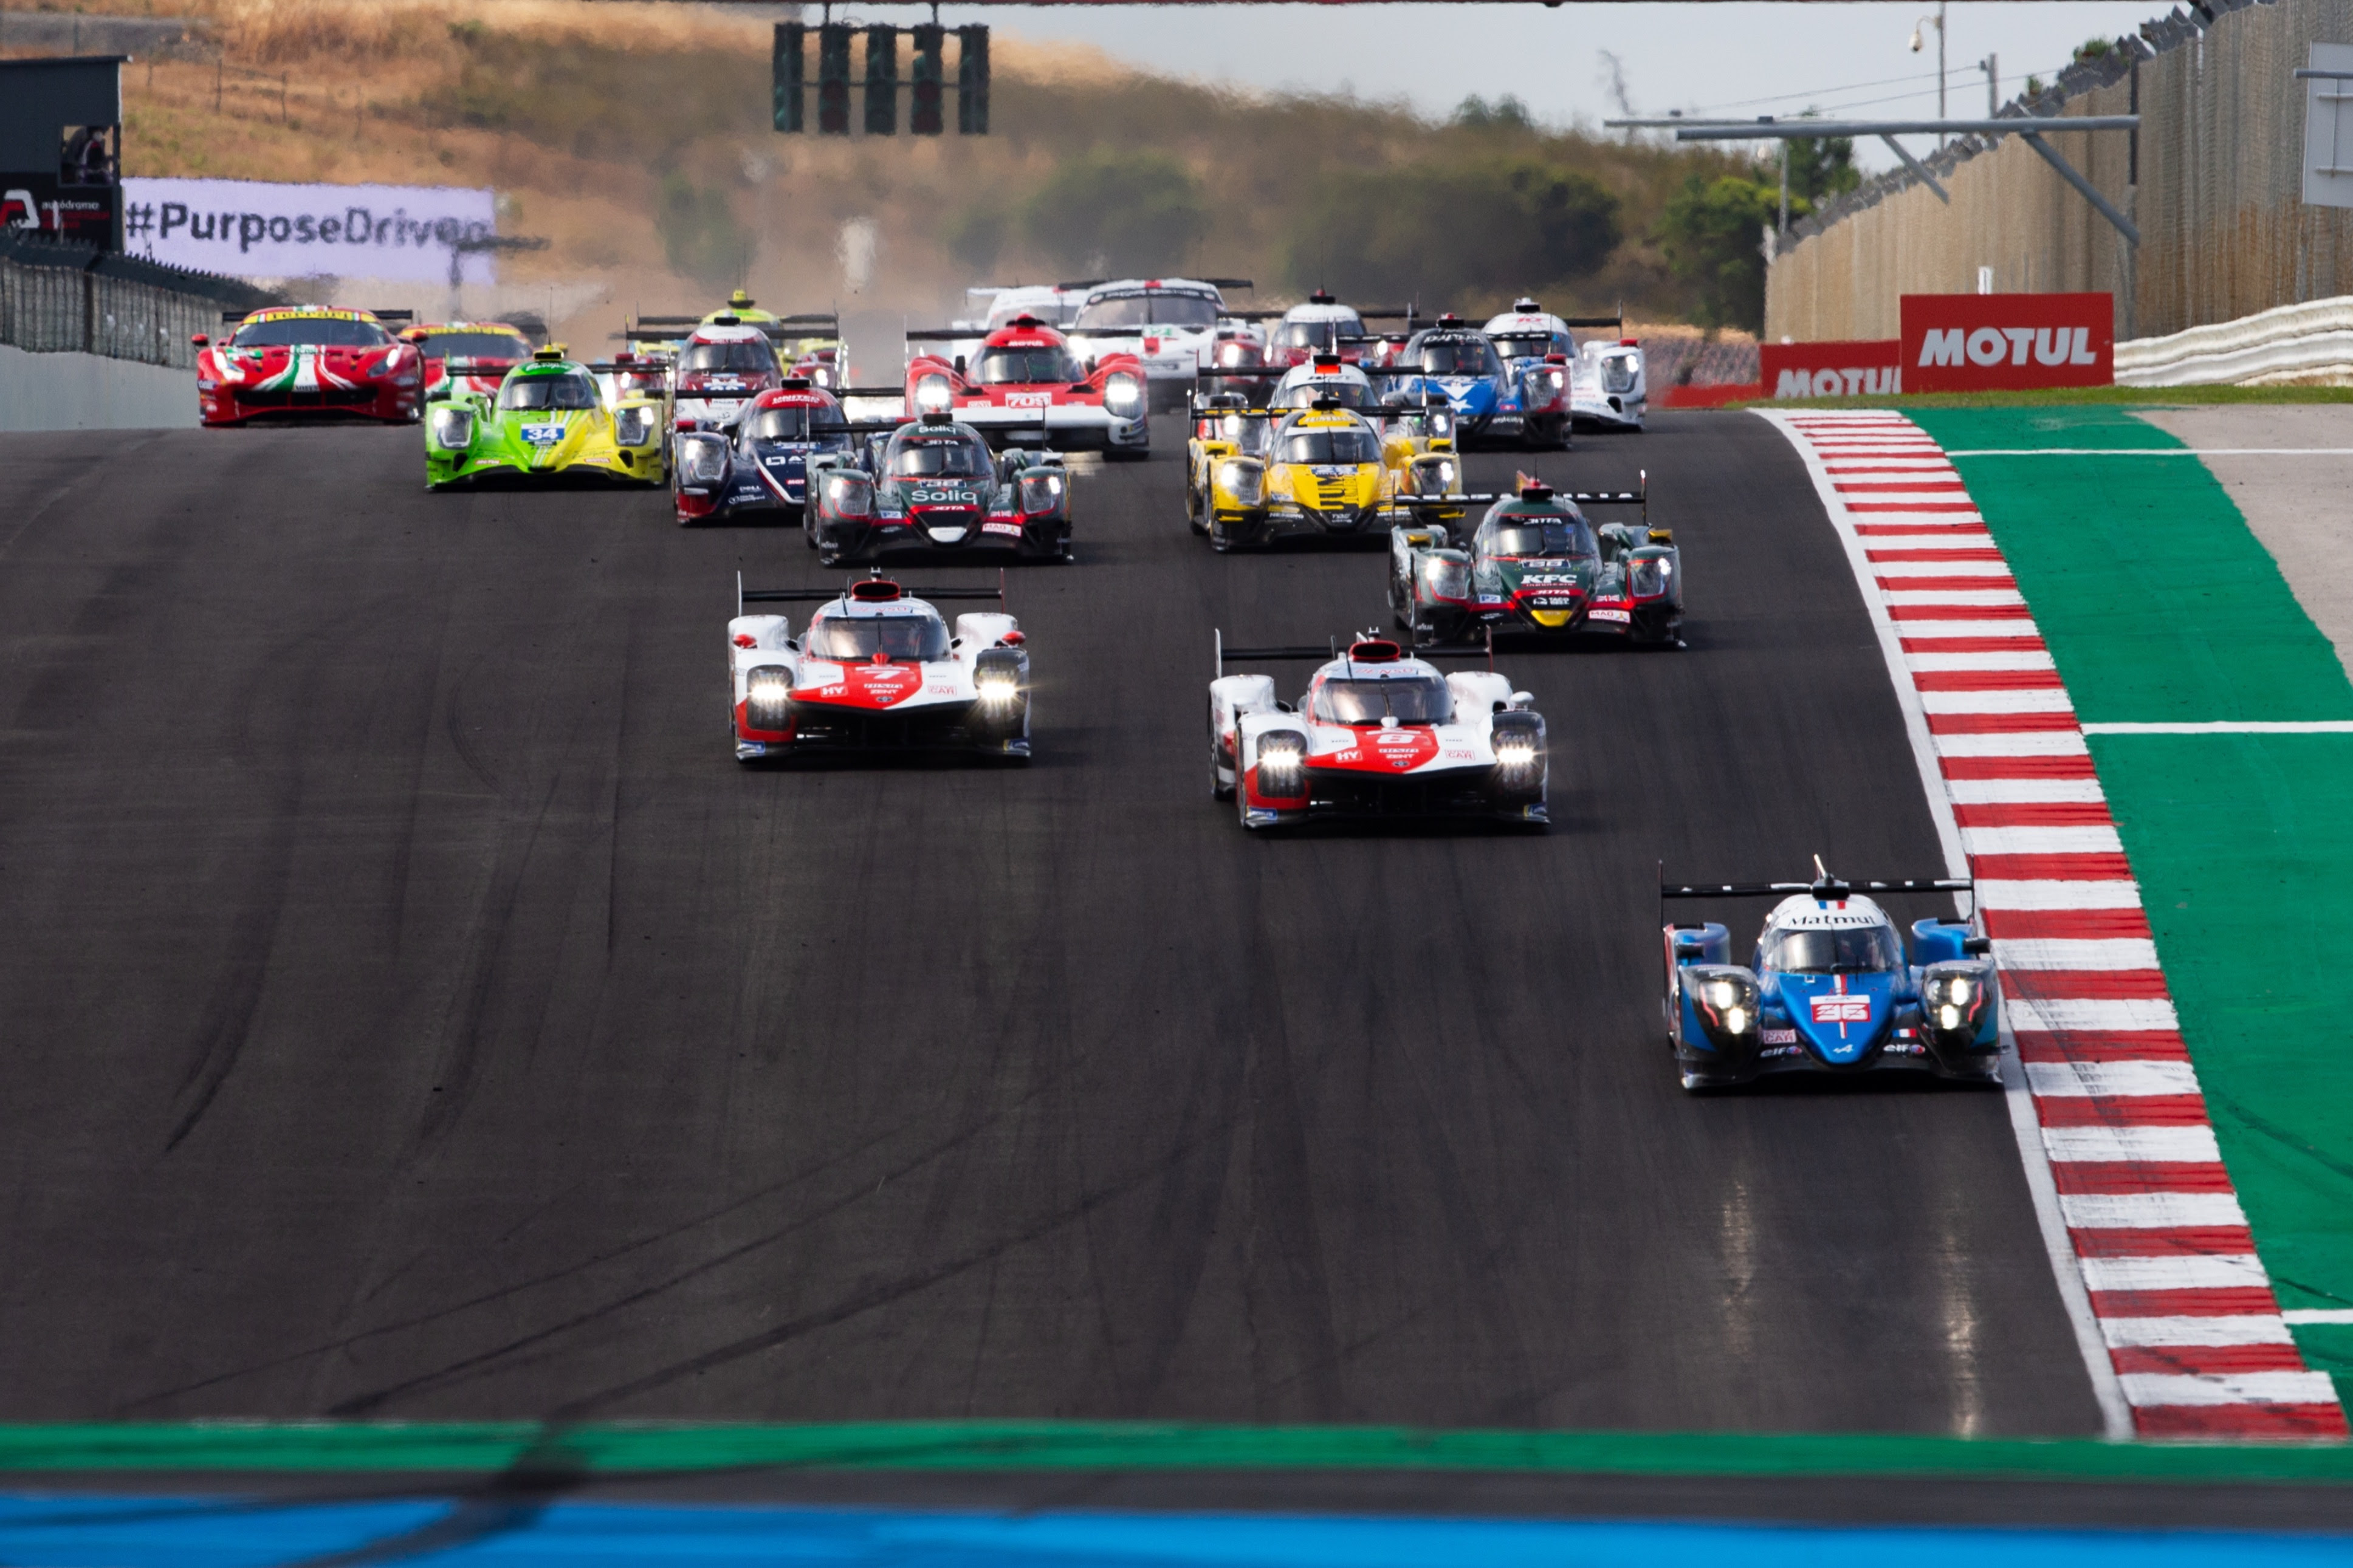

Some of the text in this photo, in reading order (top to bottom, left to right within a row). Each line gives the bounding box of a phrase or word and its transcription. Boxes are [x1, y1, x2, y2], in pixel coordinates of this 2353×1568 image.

[1918, 326, 2097, 366] MOTUL
[1008, 397, 1050, 408] 709
[527, 428, 560, 440] 34
[912, 490, 978, 505] Soliq
[1520, 574, 1578, 584] KFC
[1337, 751, 1359, 761] HY
[1815, 1004, 1869, 1021] 36
[1765, 1035, 1794, 1043] CAR
[1760, 1047, 1787, 1057] elf
